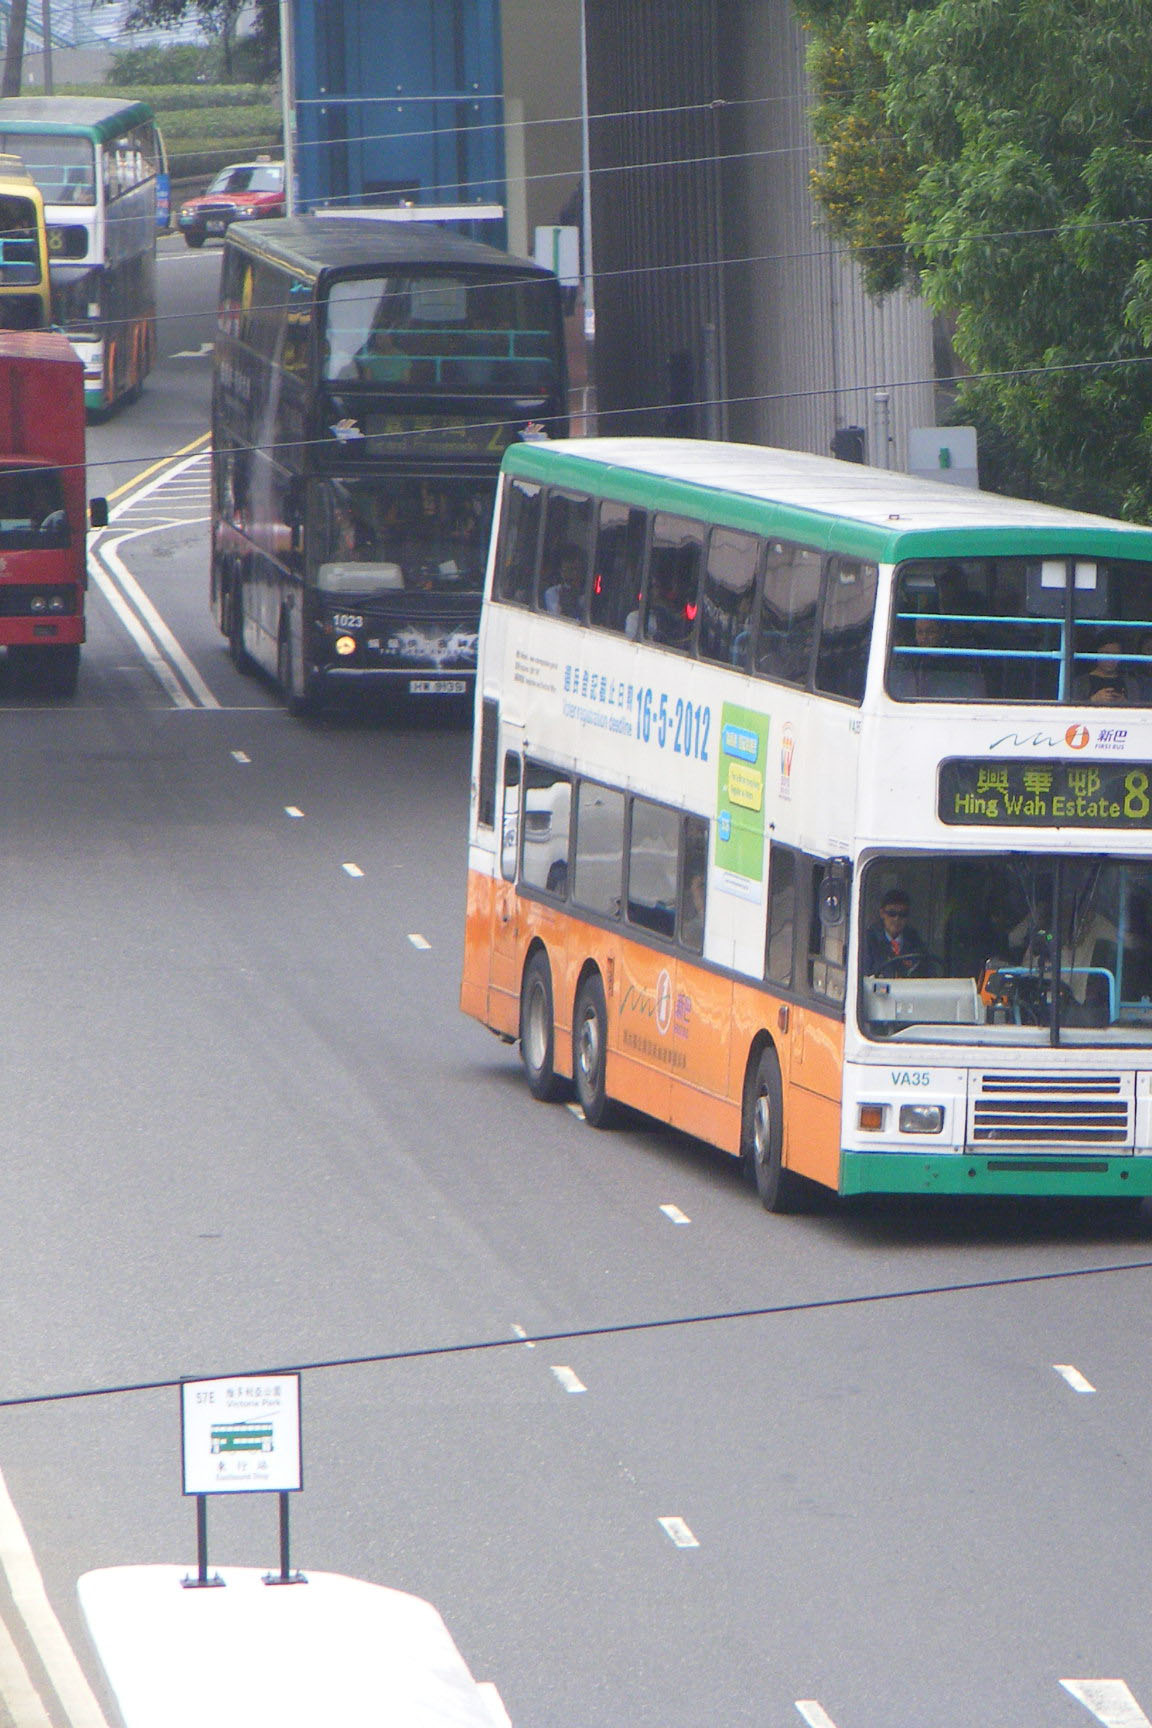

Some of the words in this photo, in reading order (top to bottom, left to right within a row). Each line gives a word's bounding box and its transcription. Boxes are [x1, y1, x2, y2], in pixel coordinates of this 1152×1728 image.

[334, 615, 363, 628] 1023
[637, 687, 710, 762] 16-5-2012
[1096, 729, 1128, 743] 新巴
[955, 793, 998, 818] Hing
[1004, 793, 1046, 816] Wah
[1052, 796, 1120, 817] Estate
[891, 1071, 930, 1086] VA35
